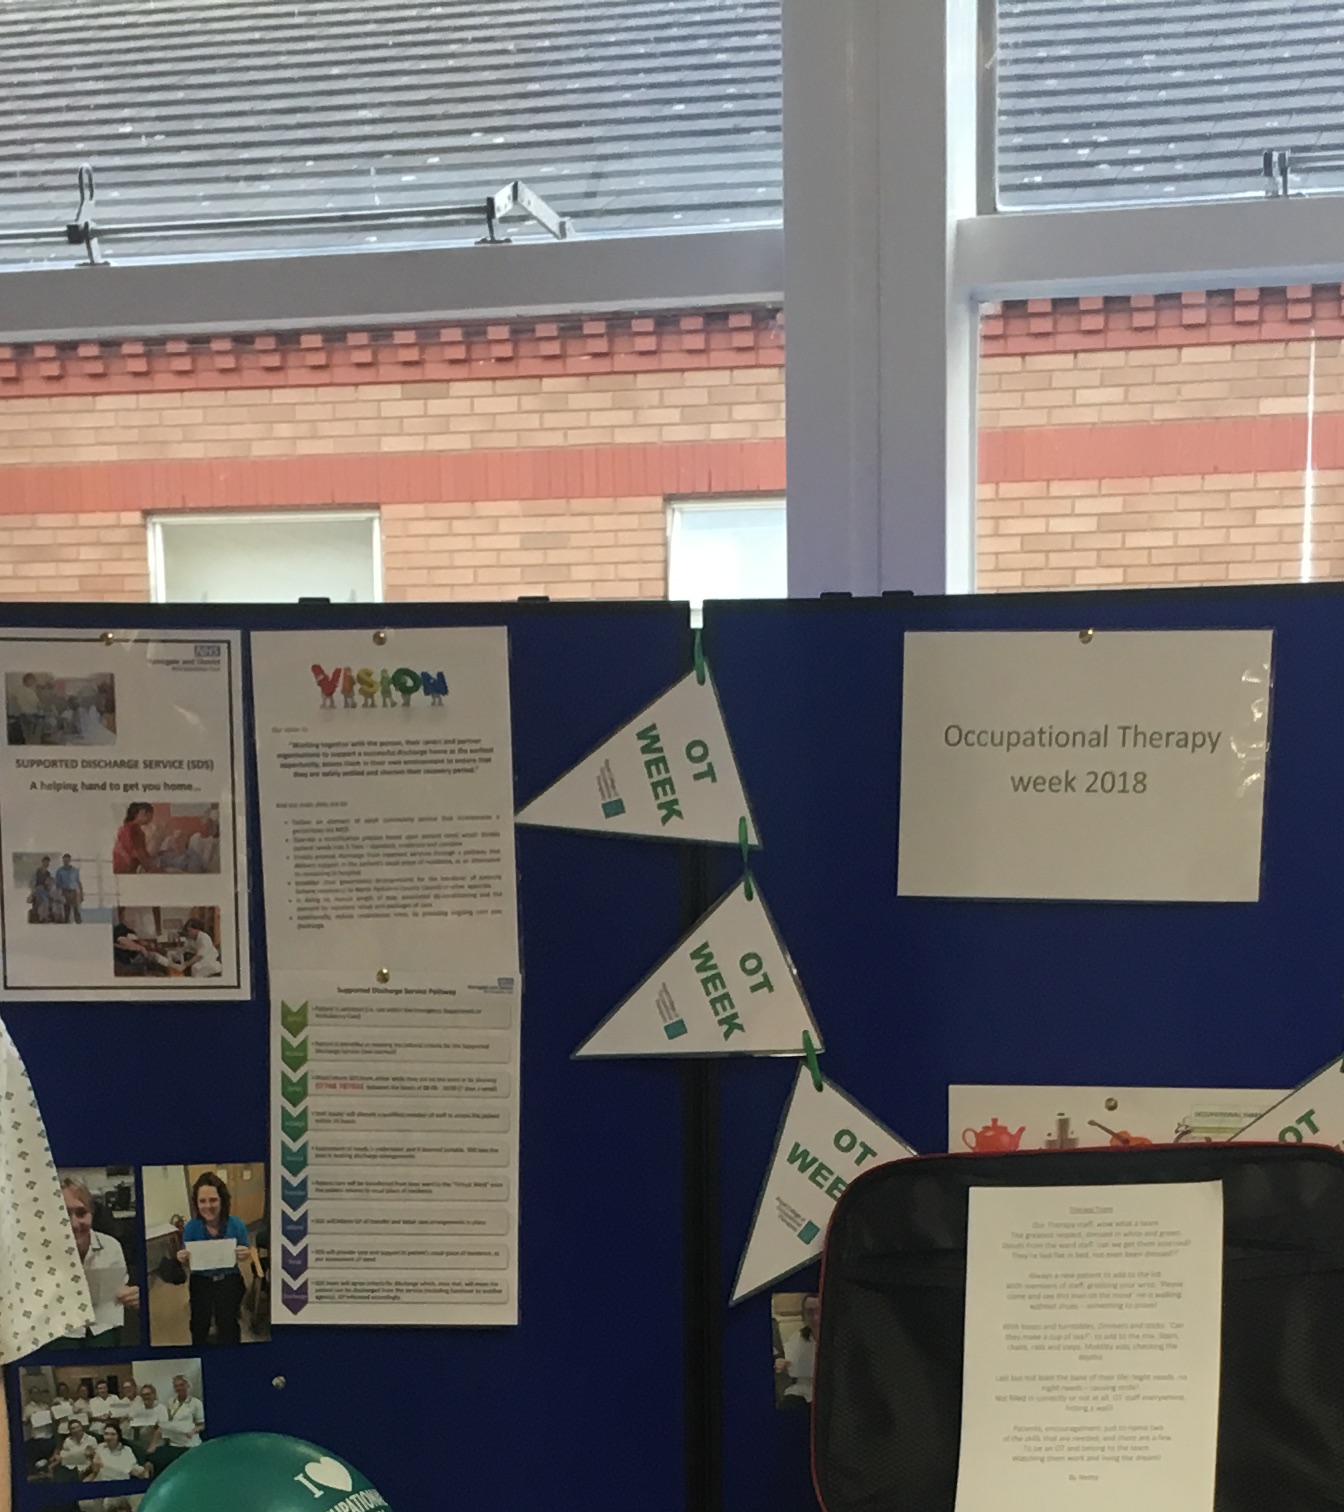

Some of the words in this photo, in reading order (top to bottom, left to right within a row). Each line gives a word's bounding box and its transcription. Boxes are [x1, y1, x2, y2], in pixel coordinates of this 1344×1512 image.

[311, 663, 449, 702] VISION
[944, 724, 1108, 752] Occupational
[1117, 724, 1222, 753] Therapy
[15, 759, 78, 769] SUPPORTED
[81, 759, 140, 770] DISCHARGE
[143, 759, 184, 770] SERVICE
[635, 722, 684, 827] WEEK
[685, 739, 717, 783] OT
[30, 781, 37, 791] A
[40, 781, 78, 792] helping
[81, 781, 107, 791] hand
[109, 782, 120, 791] to
[123, 782, 139, 792] get
[142, 784, 161, 792] you
[1010, 770, 1077, 793] week
[1085, 770, 1147, 794] 2018
[689, 940, 746, 1042] WEEK
[739, 952, 775, 994] OT
[1278, 1109, 1320, 1143] OT
[833, 1128, 878, 1166] OT
[786, 1141, 849, 1202] WEE
[293, 1472, 324, 1498] I
